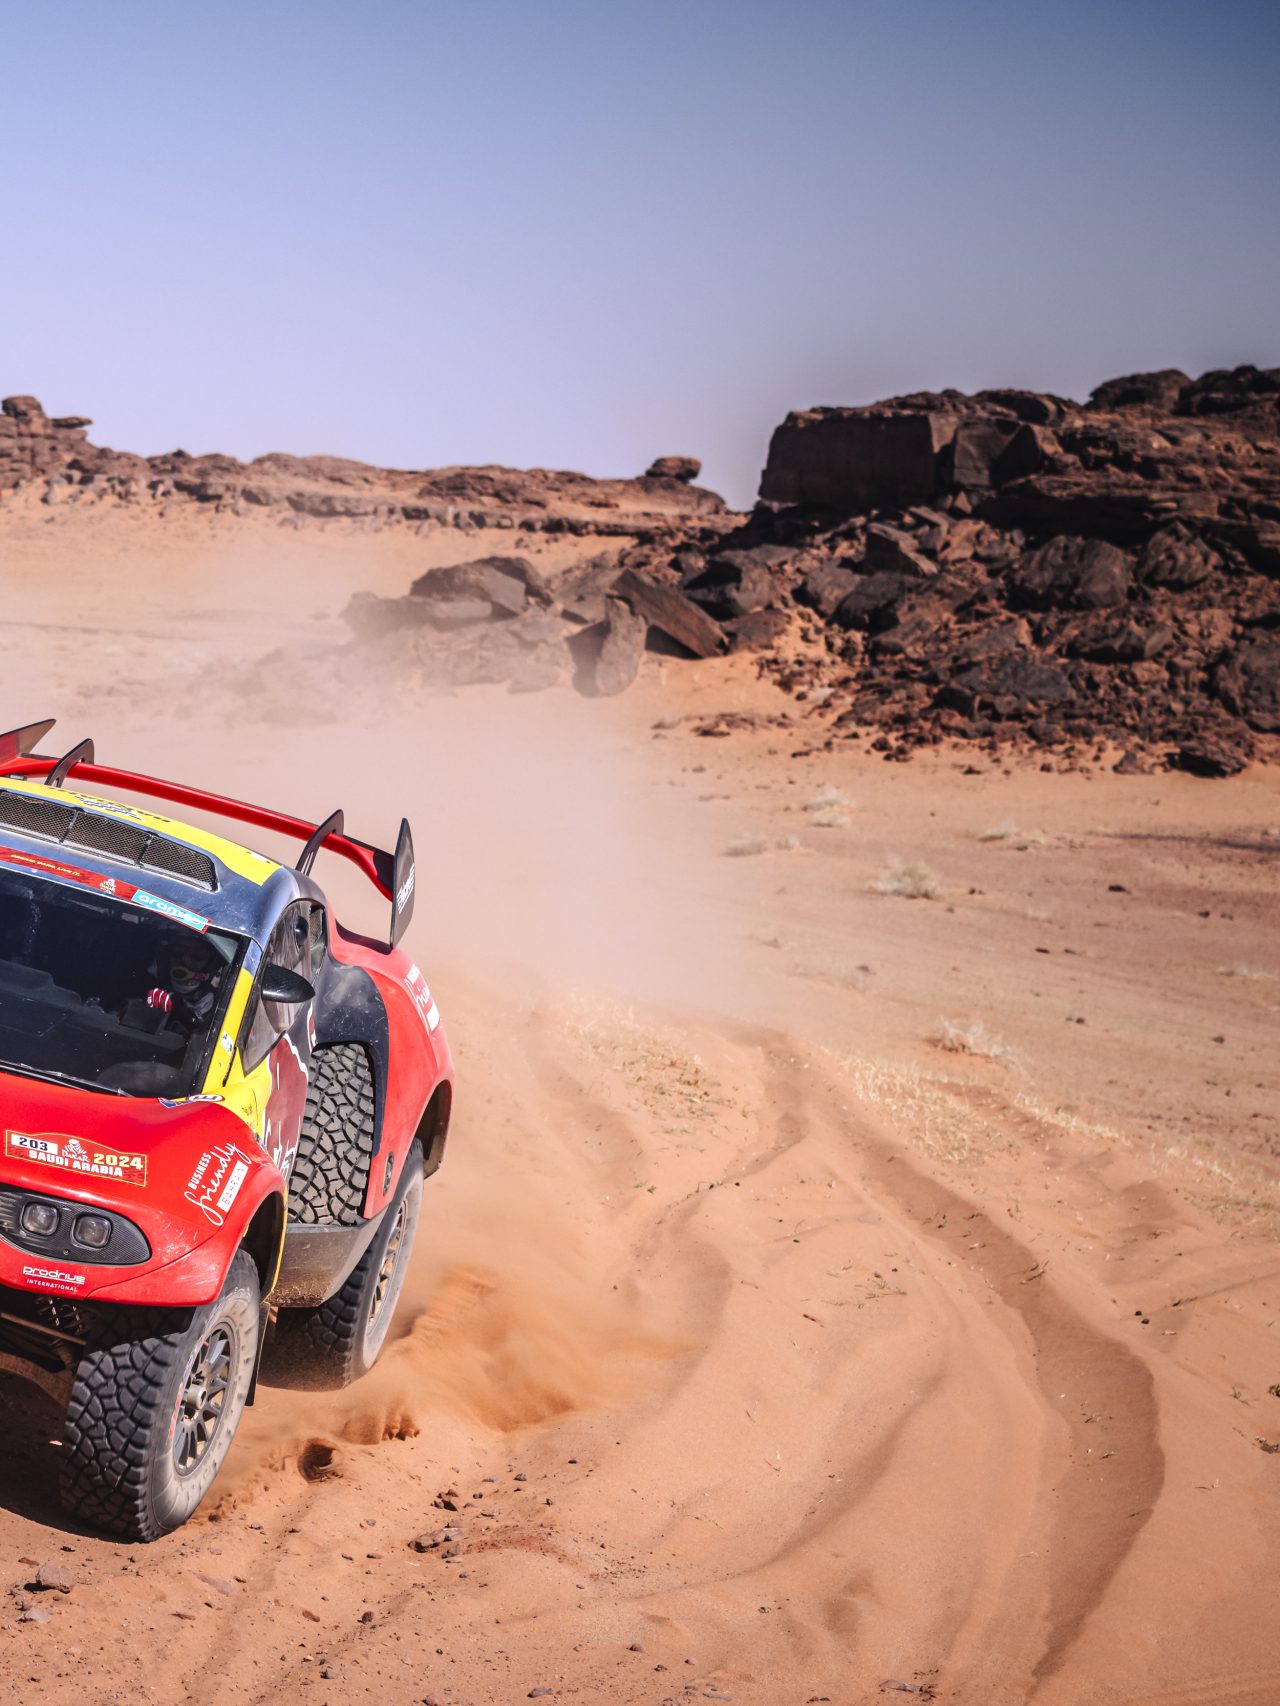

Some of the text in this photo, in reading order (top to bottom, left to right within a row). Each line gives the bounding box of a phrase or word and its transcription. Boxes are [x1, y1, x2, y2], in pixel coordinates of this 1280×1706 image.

[19, 1137, 49, 1152] 203
[28, 1149, 124, 1178] SAUDI ARABIA
[93, 1153, 144, 1170] 2024
[187, 1152, 213, 1191] BUSINESS
[22, 1265, 86, 1285] prodrive
[26, 1278, 79, 1293] INTERNATIONAL
